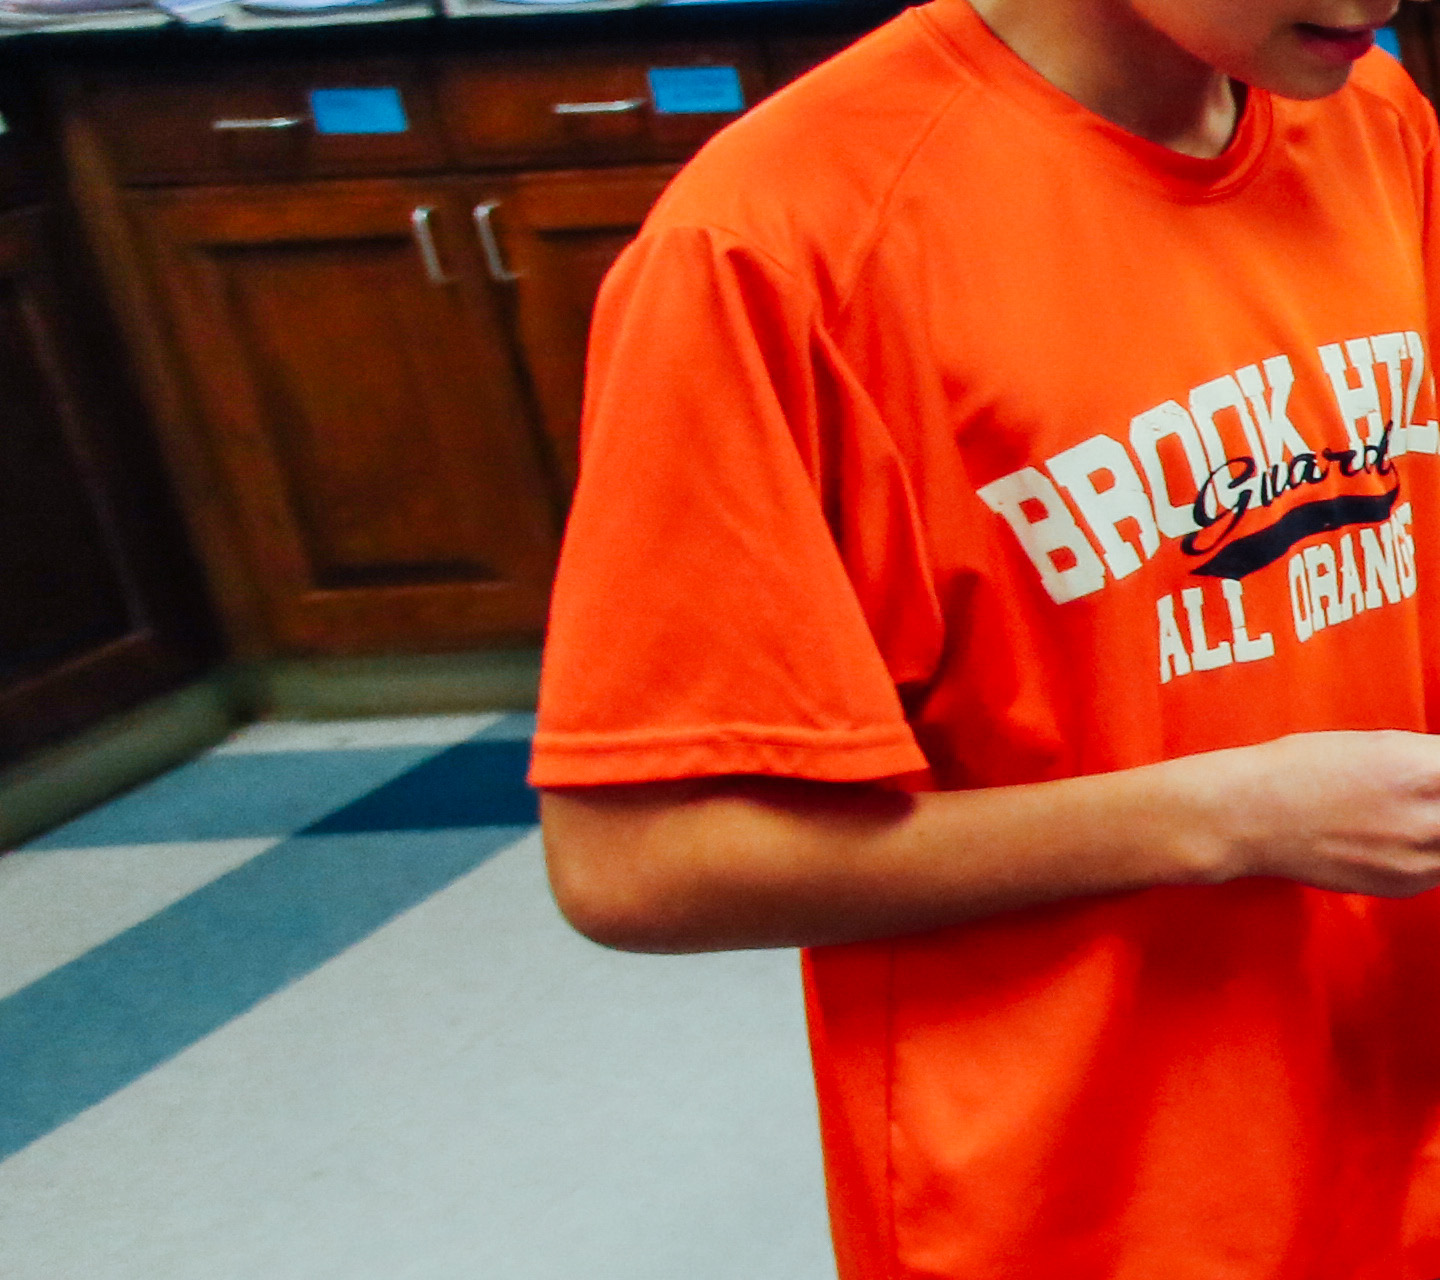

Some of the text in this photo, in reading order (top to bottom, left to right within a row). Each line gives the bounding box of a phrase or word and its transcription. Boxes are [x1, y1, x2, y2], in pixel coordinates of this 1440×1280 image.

[976, 354, 1310, 605] BROOK
[1180, 420, 1398, 556] Guard
[1157, 578, 1274, 684] ALL
